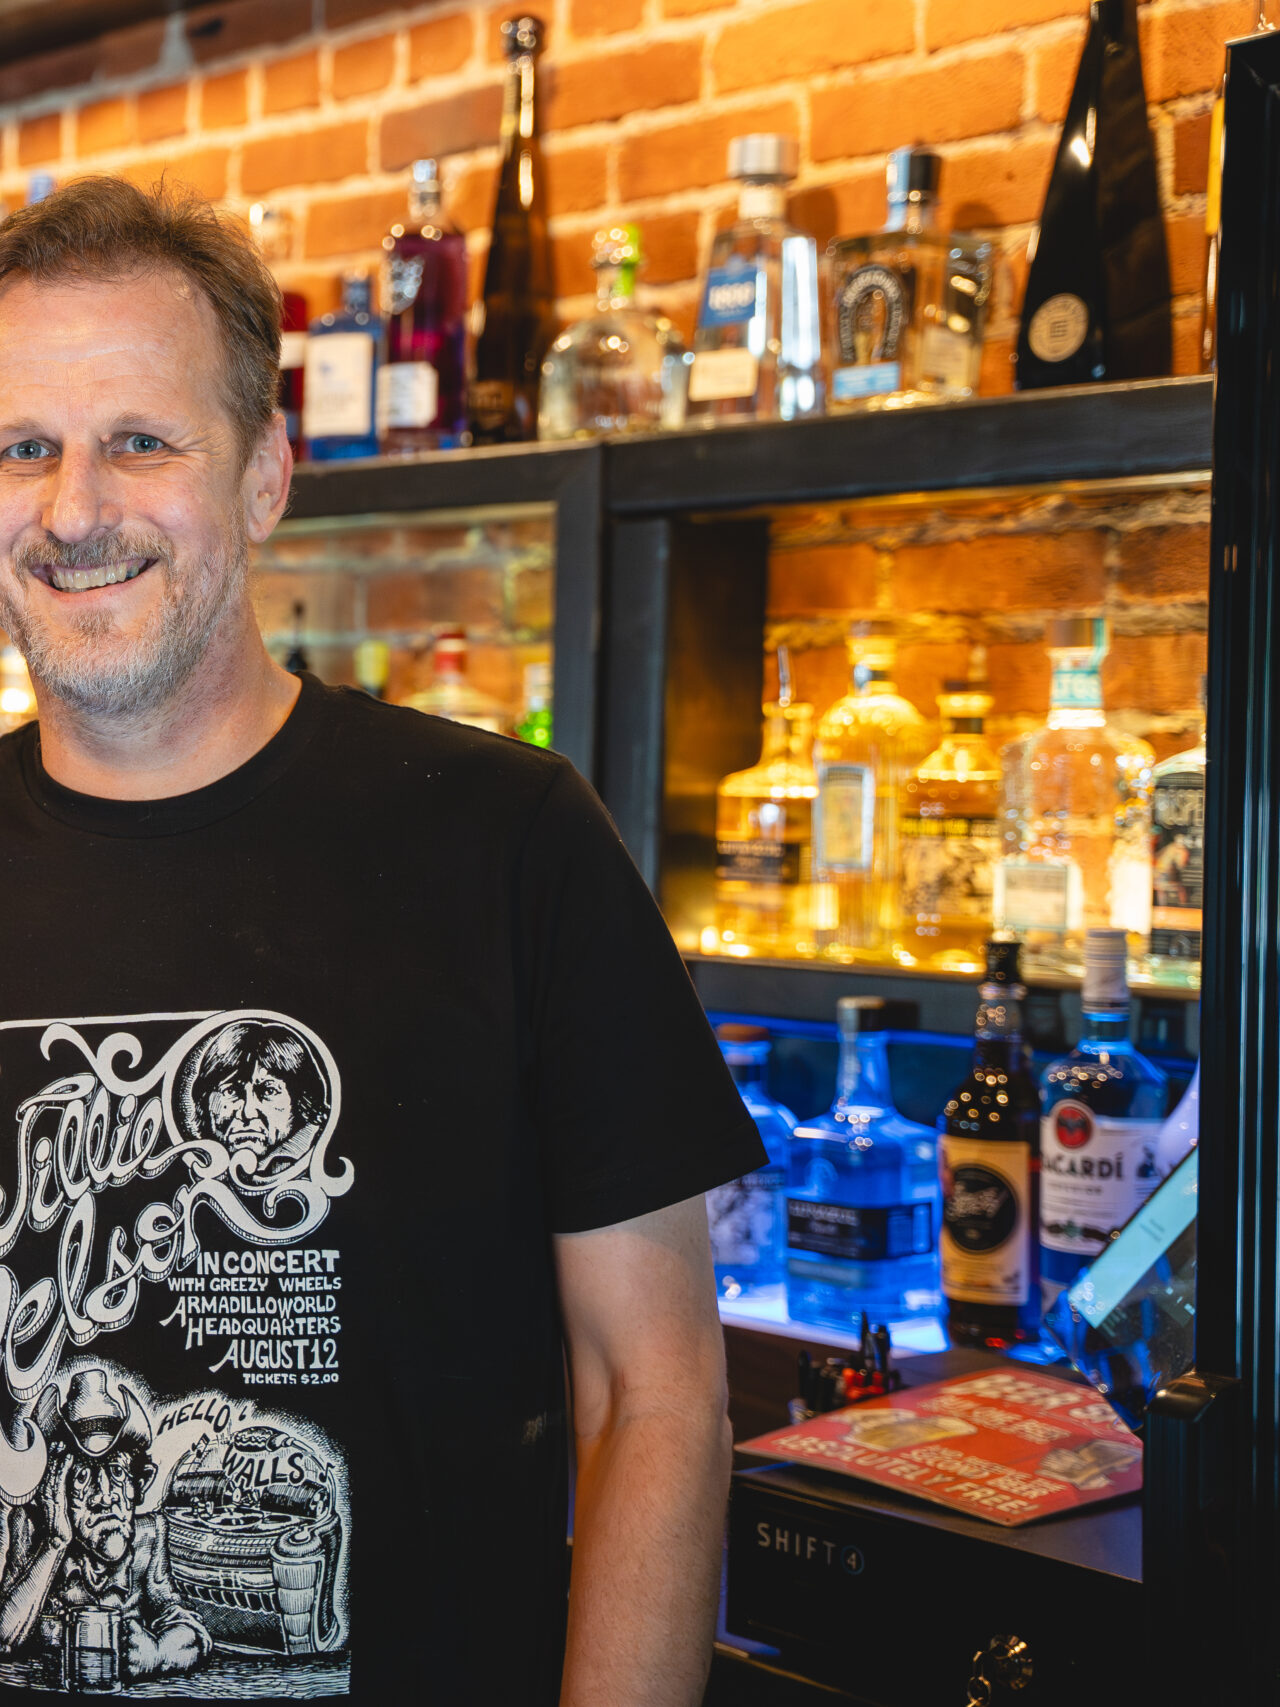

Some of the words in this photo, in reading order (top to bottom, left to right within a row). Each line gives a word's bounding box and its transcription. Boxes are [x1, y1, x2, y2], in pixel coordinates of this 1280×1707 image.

[196, 1252, 219, 1275] IN
[223, 1250, 340, 1275] CONCERT
[168, 1277, 205, 1292] WITH
[209, 1277, 269, 1292] GREEZY
[278, 1276, 342, 1292] WHEELS
[185, 1316, 342, 1350] HEADQUARTERS
[243, 1373, 297, 1385] TICKETS
[300, 1372, 339, 1385] $2.00
[156, 1398, 231, 1436] HELLO
[222, 1443, 305, 1488] WALLS
[757, 1522, 837, 1566] SHIFT
